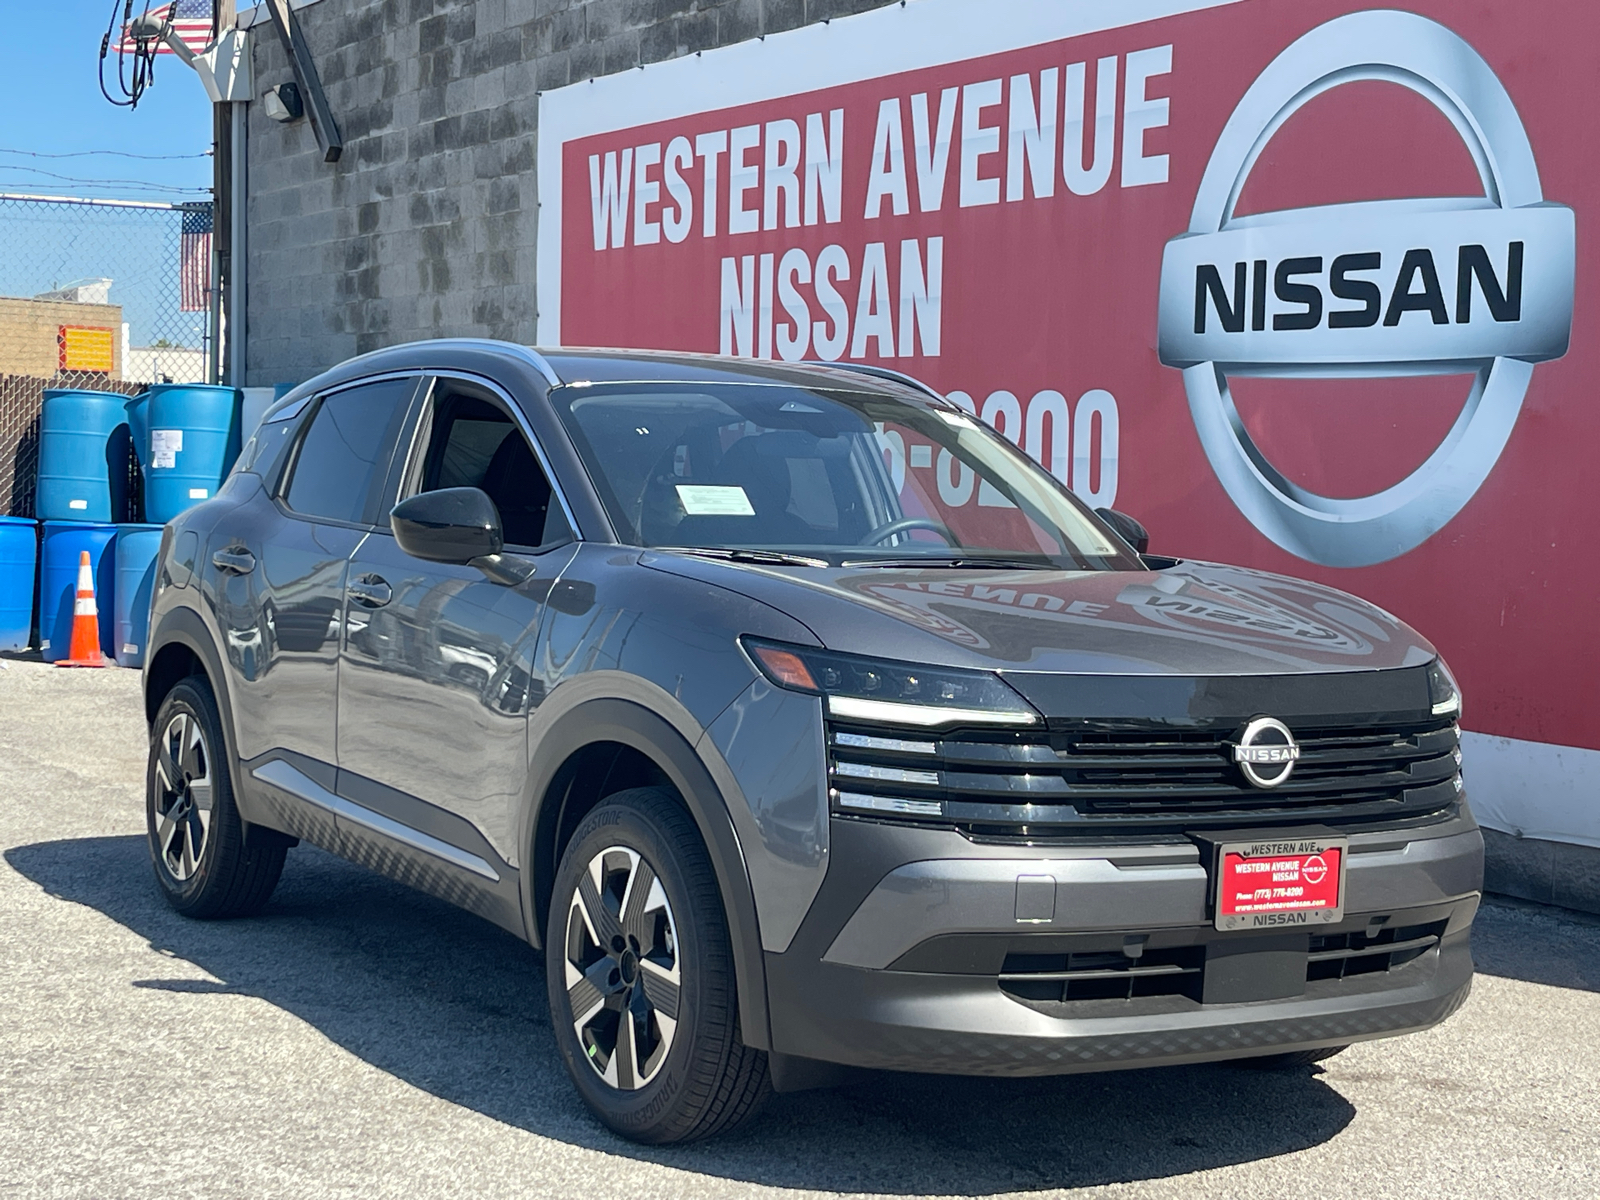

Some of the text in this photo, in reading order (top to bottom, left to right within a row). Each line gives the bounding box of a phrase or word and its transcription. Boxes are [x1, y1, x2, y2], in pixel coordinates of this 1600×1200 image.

[588, 44, 1173, 252] WESTERN AVENUE
[1194, 241, 1524, 334] NISSAN
[720, 237, 943, 362] NISSAN
[1237, 747, 1299, 760] NISSAN
[1251, 842, 1316, 855] WESTERN AVE
[1235, 861, 1299, 873] WESTERN AVENUE
[1272, 871, 1299, 882] NISSAN
[1254, 888, 1272, 901] (773)
[1253, 912, 1307, 926] NISSAN
